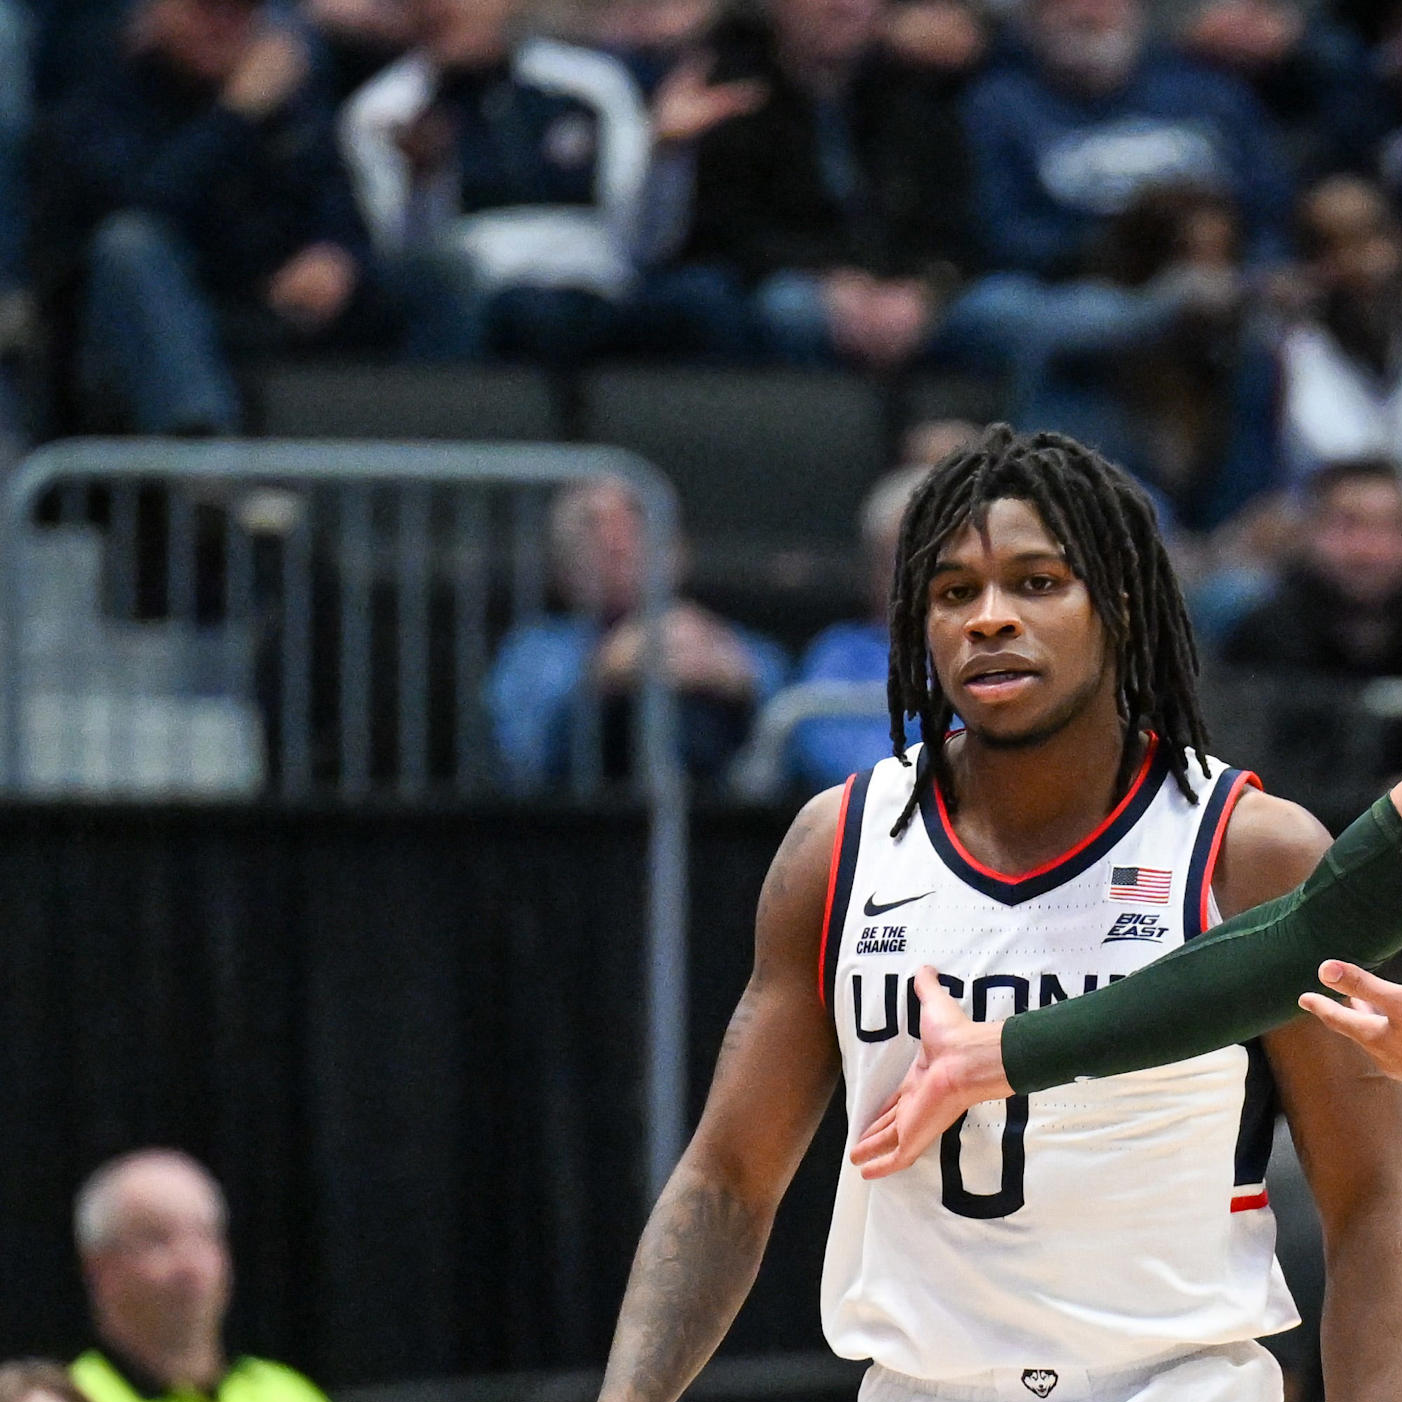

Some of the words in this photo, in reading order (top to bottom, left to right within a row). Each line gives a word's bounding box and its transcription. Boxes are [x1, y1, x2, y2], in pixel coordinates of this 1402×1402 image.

[1114, 913, 1160, 926] BIG
[861, 926, 877, 940] BE
[882, 926, 907, 939] THE
[1106, 925, 1170, 939] EAST
[856, 939, 907, 954] CHANGE
[852, 973, 1126, 1043] UCO
